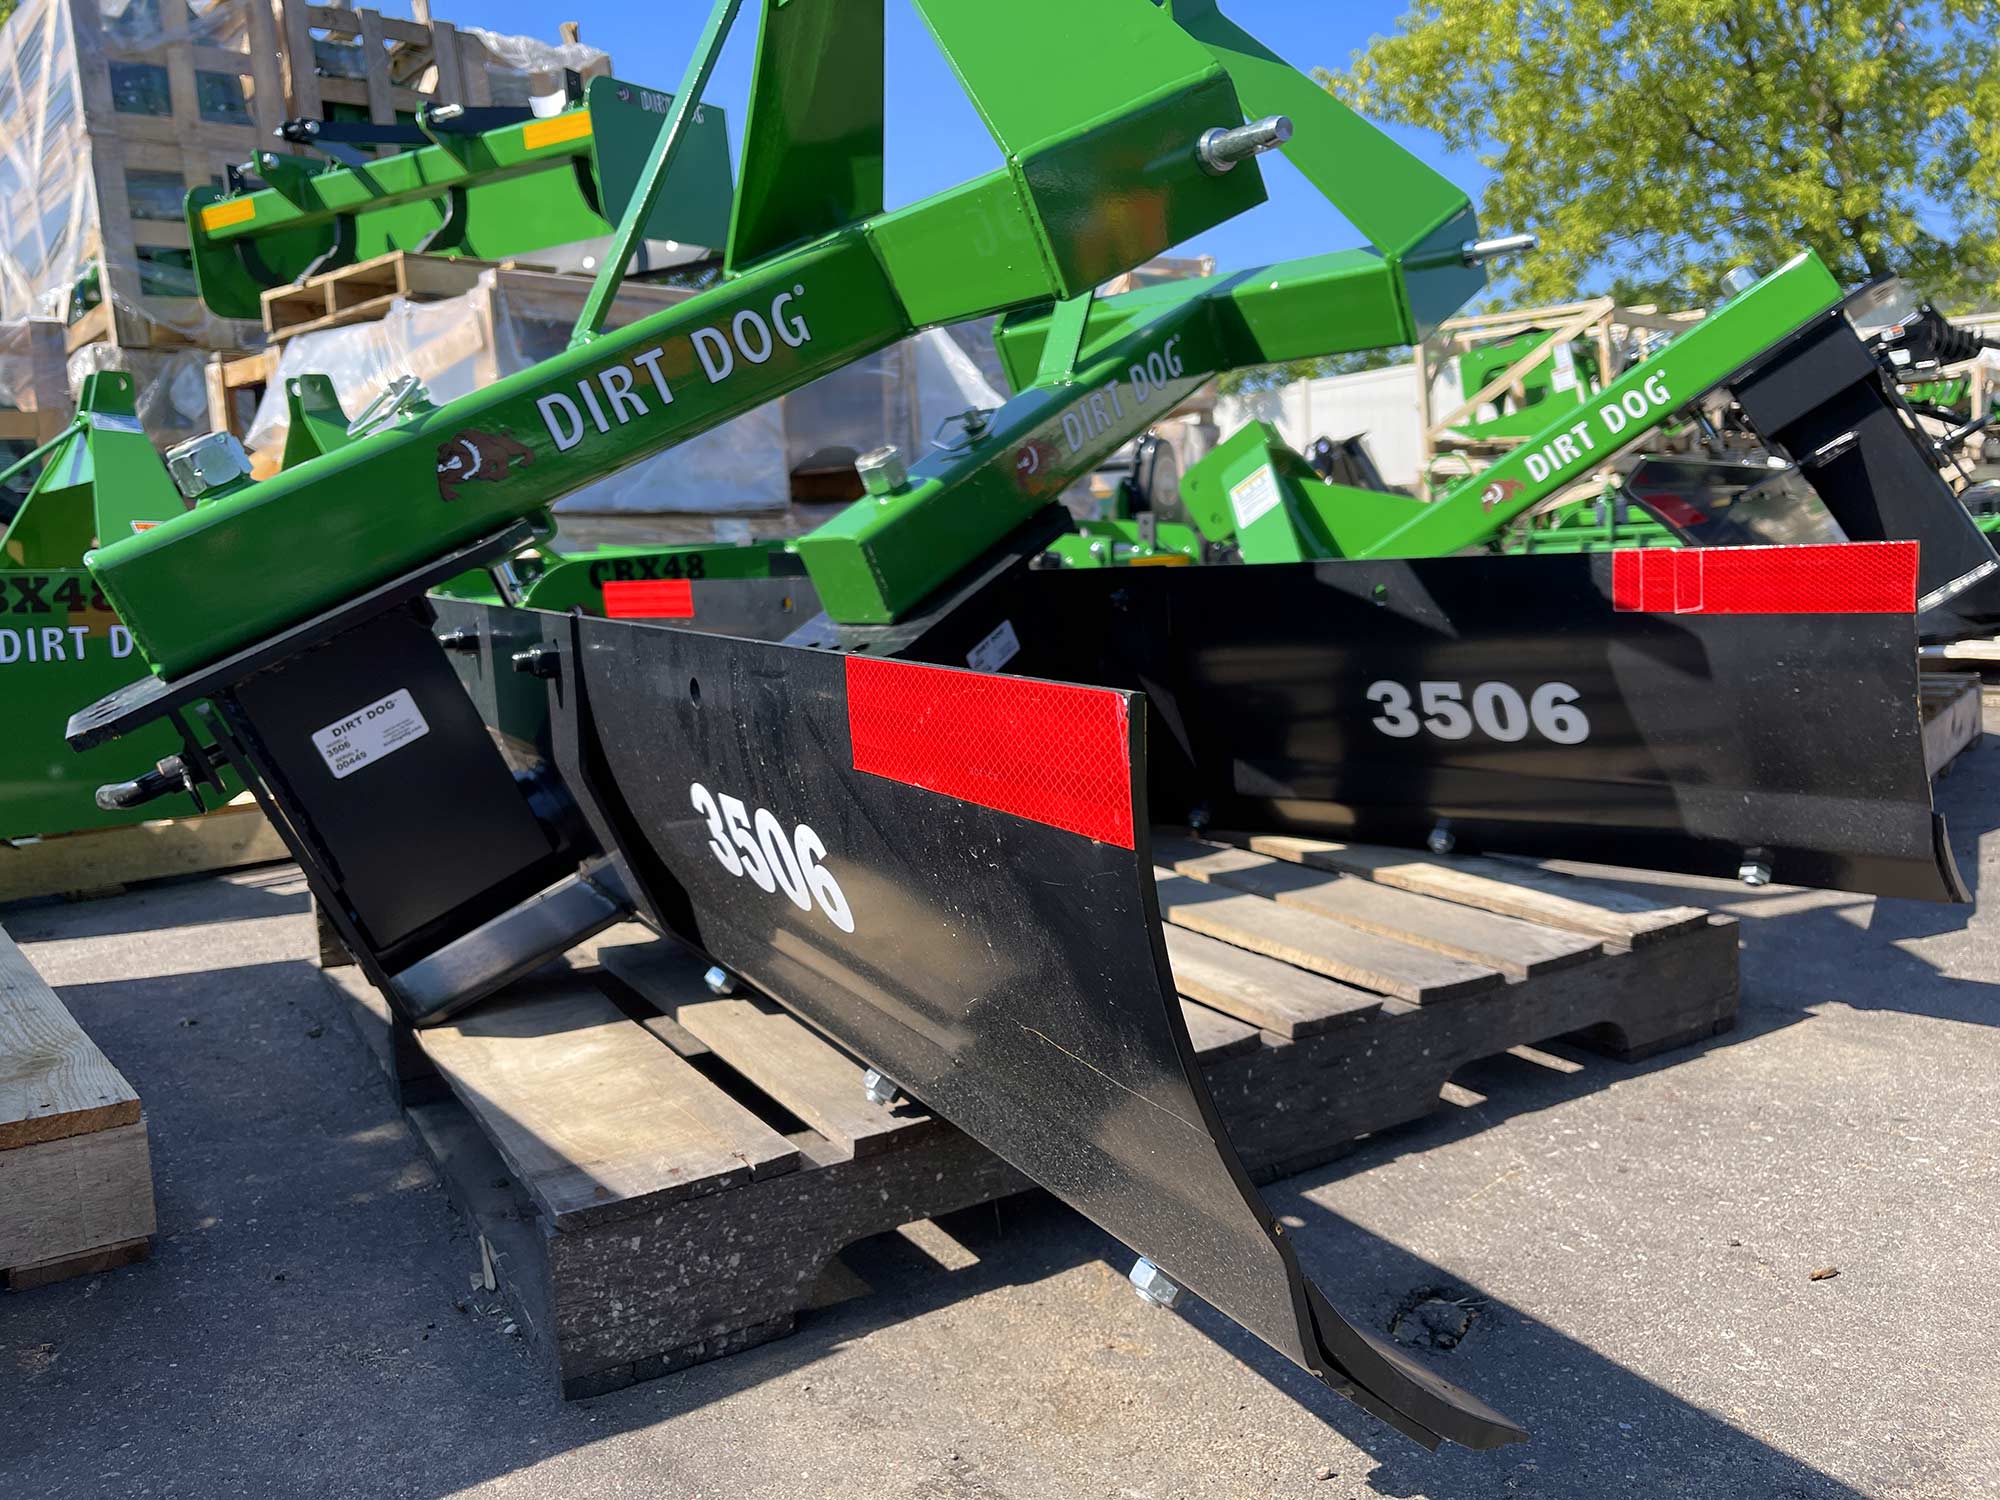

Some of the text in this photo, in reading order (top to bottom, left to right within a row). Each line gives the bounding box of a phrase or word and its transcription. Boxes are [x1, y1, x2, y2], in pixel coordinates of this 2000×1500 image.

[536, 347, 674, 452] DIRT
[1061, 379, 1124, 453] DIRT
[1524, 420, 1595, 483] DIRT
[0, 624, 90, 664] DIRT
[331, 715, 362, 737] DIRT
[366, 699, 396, 720] DOG
[1366, 679, 1591, 745] 3506
[326, 741, 351, 758] 3506
[690, 782, 855, 934] 3506
